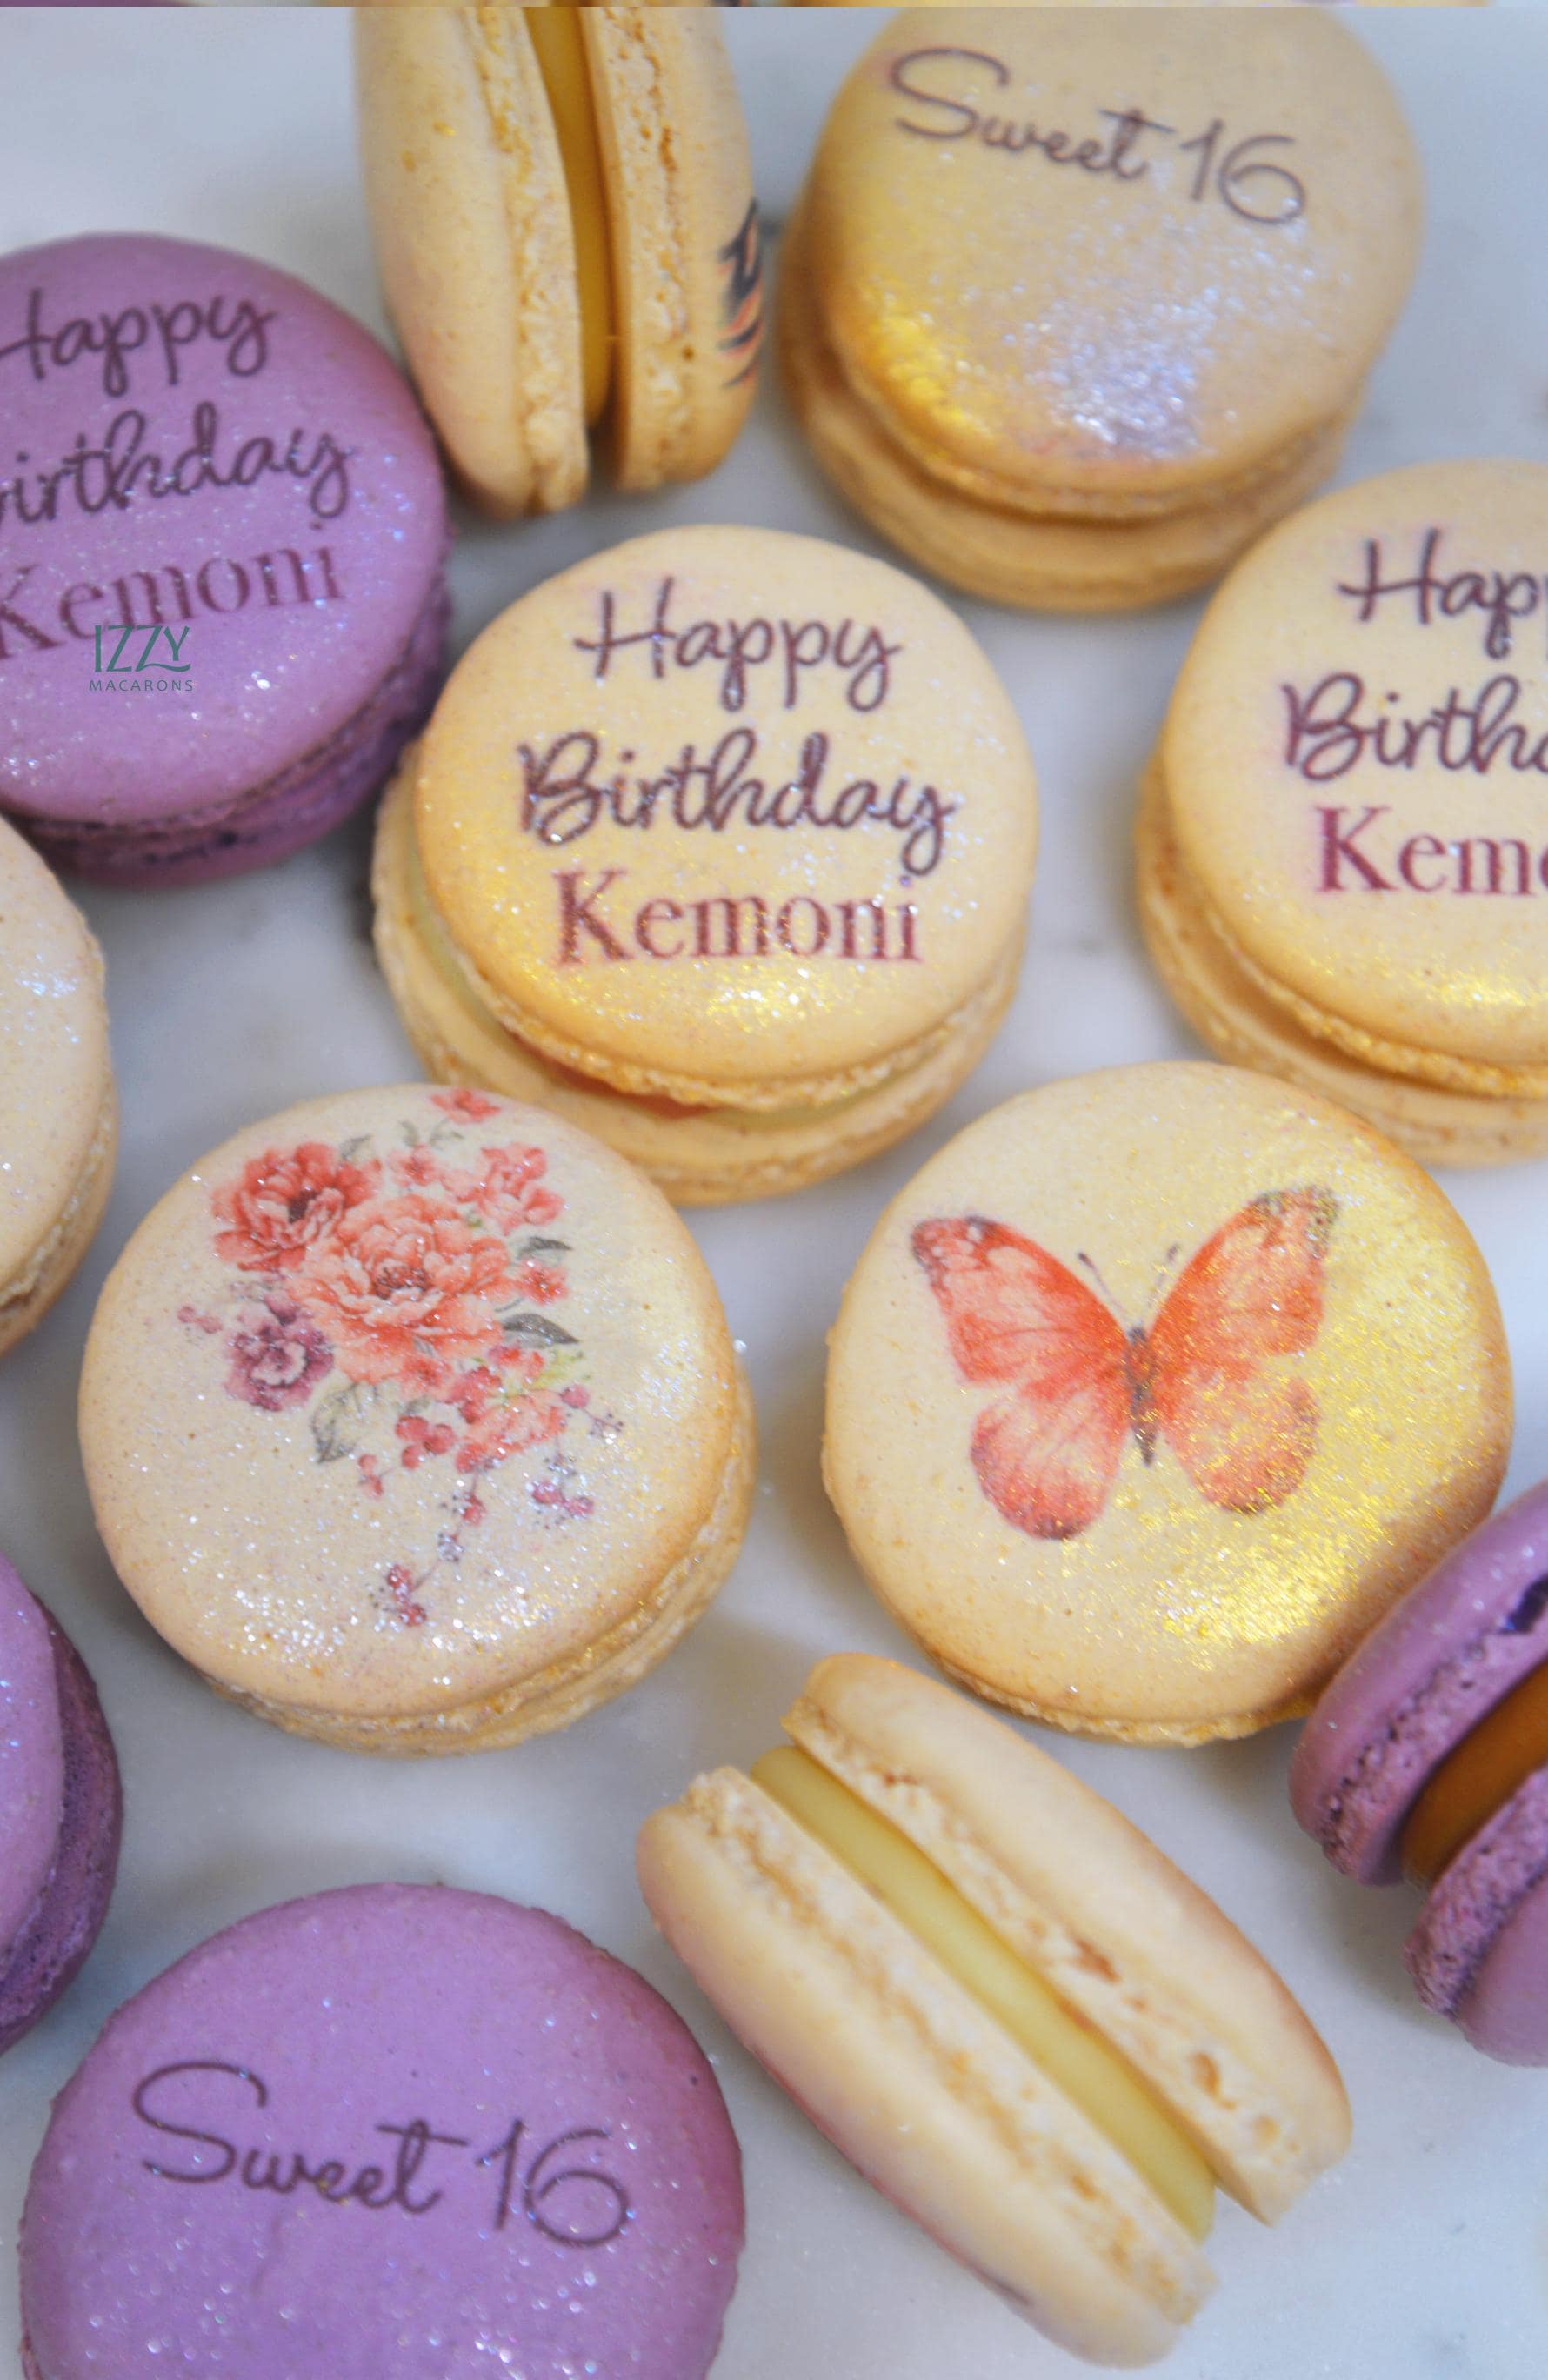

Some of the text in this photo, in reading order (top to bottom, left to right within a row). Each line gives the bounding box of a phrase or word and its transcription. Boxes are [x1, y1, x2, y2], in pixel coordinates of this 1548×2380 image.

[890, 47, 1307, 225] Sweet 16
[0, 400, 355, 522] irthday
[573, 575, 903, 712] Happy
[1336, 527, 1548, 660] Hap
[517, 727, 957, 877] Birthday
[1312, 804, 1548, 897] Kem
[551, 869, 924, 968] Kemoni
[131, 2060, 631, 2249] Sweet 16
